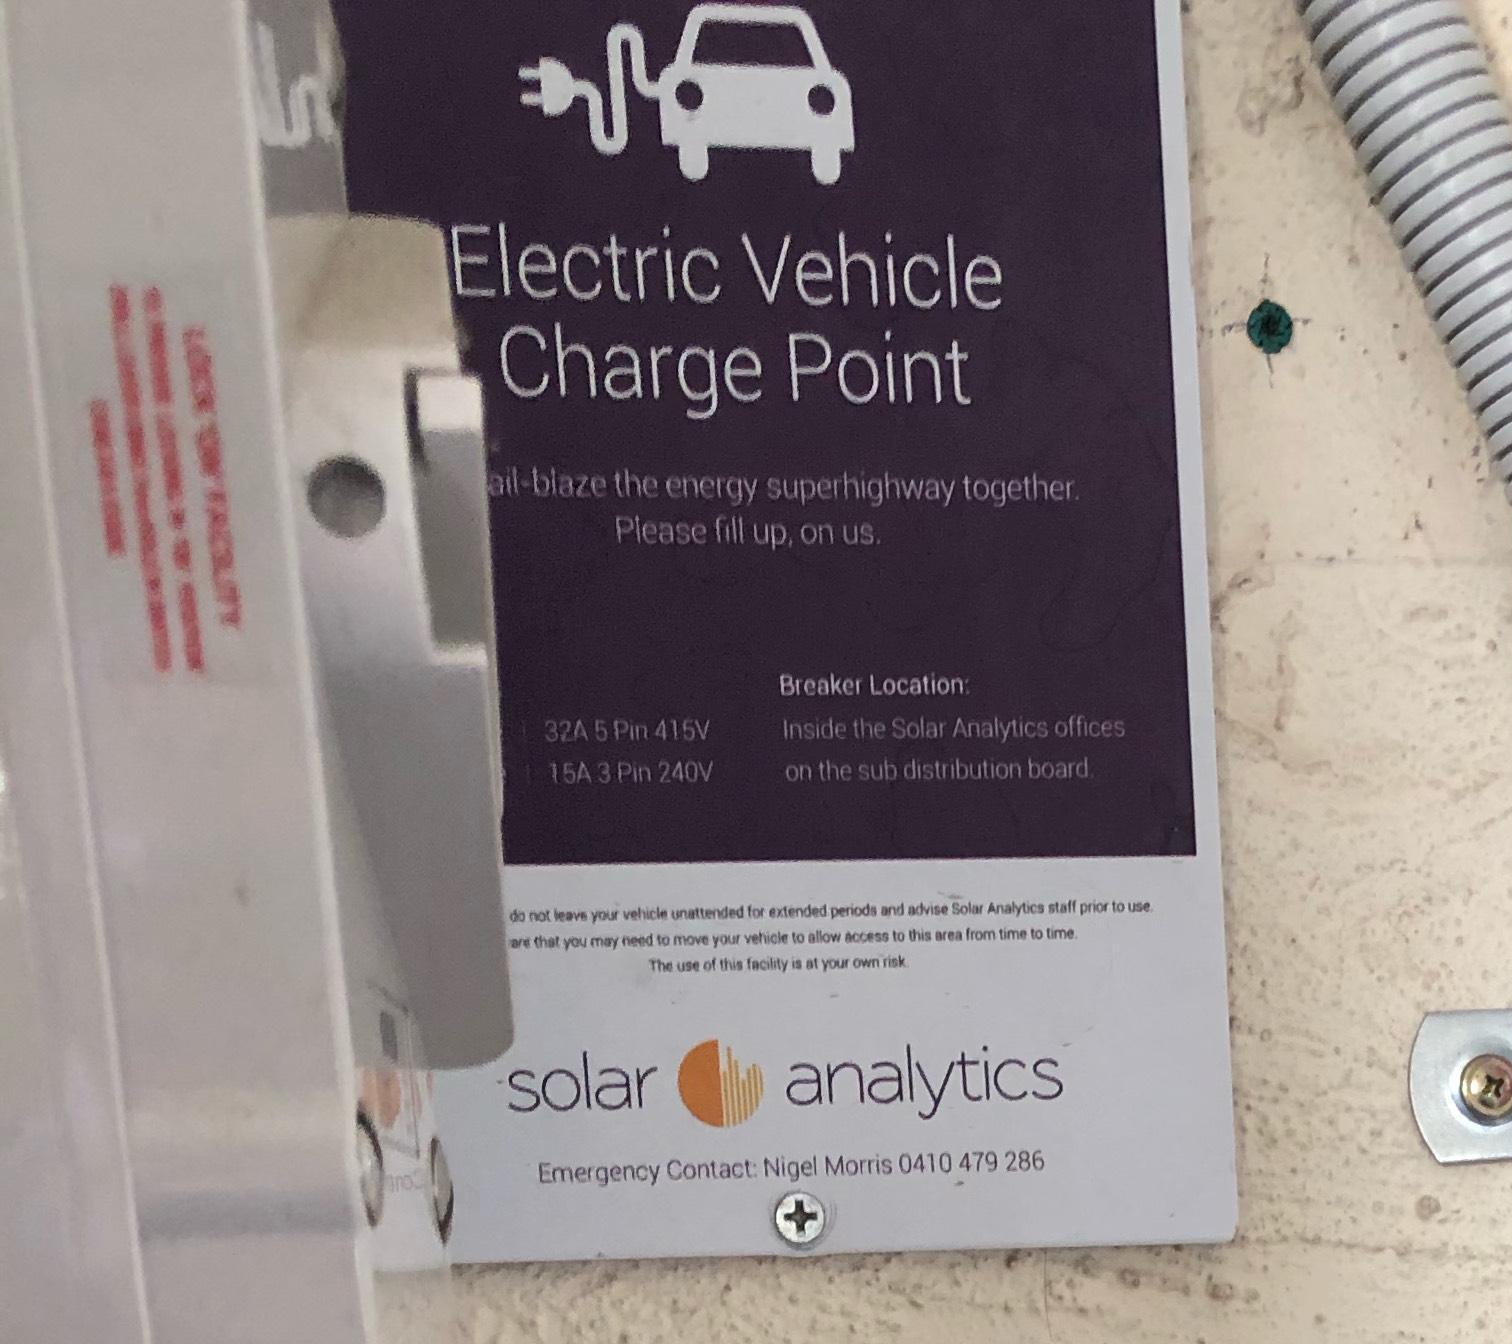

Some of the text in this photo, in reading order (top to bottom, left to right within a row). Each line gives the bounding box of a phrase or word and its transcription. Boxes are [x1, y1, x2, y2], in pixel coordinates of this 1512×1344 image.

[451, 222, 1002, 310] Electric Vehicle
[500, 322, 971, 419] Charge Point
[615, 468, 658, 498] the
[665, 476, 758, 506] energy
[767, 470, 955, 507] superhighway
[962, 472, 1080, 507] together.
[615, 514, 881, 550] Please fill up, on us.
[779, 672, 970, 696] Breaker Location:
[544, 718, 710, 742] 32A 5 Pin 415V
[782, 715, 1126, 743] Inside the Solar Analytics offices
[551, 760, 713, 784] 15A 3 Pin 240V
[785, 762, 812, 782] on
[818, 759, 852, 781] the
[857, 759, 897, 781] sub
[903, 757, 1021, 780] distribution
[509, 908, 526, 923] do
[528, 908, 551, 923] not
[553, 907, 588, 922] leave
[591, 909, 619, 924] your
[622, 906, 668, 921] vehicle
[671, 905, 744, 920] unattended
[747, 904, 766, 919] for
[768, 903, 827, 919] extended
[830, 903, 877, 920] periods
[880, 902, 905, 917] and
[907, 902, 949, 917] advise
[951, 901, 984, 916] Solar
[987, 900, 1045, 918] Analytics
[1048, 900, 1077, 915] staff
[1079, 899, 1108, 916] prior
[1111, 901, 1125, 913] to
[533, 935, 560, 949] that
[563, 937, 587, 951] you
[590, 936, 619, 950] may
[621, 933, 654, 947] need
[656, 934, 671, 947] to
[673, 935, 709, 947] move
[712, 935, 740, 949] your
[744, 931, 788, 945] vehicle
[791, 931, 805, 945] to
[807, 930, 841, 944] allow
[844, 931, 889, 943] access
[892, 929, 906, 943] to
[908, 928, 932, 942] this
[935, 930, 963, 942] area
[965, 928, 996, 941] from
[998, 927, 1027, 941] time
[1030, 928, 1044, 940] to
[649, 959, 673, 972] The
[676, 960, 700, 973] use
[702, 957, 717, 972] of
[719, 957, 743, 971] this
[746, 956, 788, 973] facility
[791, 957, 802, 970] is
[805, 957, 818, 970] at
[821, 958, 849, 973] your
[852, 957, 880, 969] own
[507, 1044, 1064, 1120] solar analytics
[538, 1149, 1046, 1186] Emergency Contact: Nigel Morris 0410 479 286
